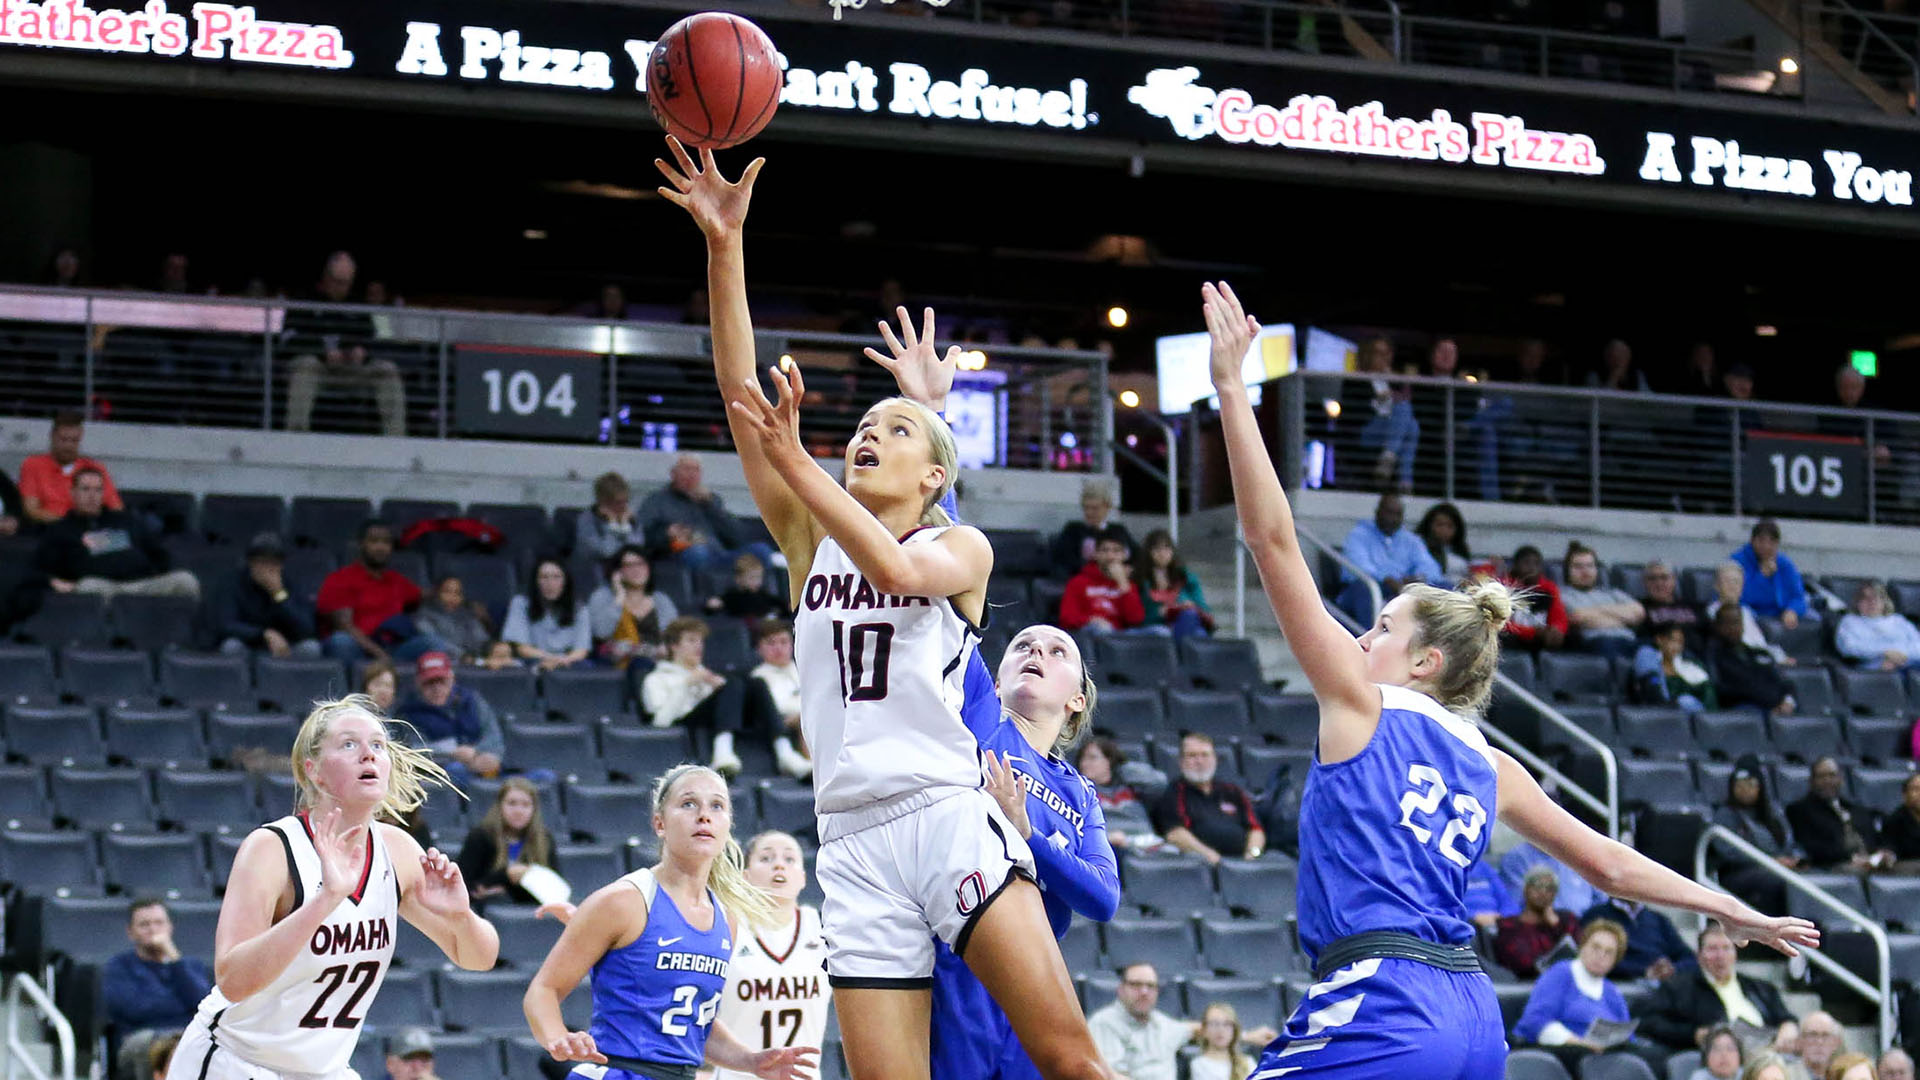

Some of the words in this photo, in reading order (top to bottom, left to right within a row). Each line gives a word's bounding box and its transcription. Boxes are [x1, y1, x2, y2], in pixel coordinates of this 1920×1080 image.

[396, 22, 447, 75] A
[460, 26, 614, 90] Pizza
[777, 52, 879, 111] an't
[889, 62, 1088, 129] Refuse!
[1215, 90, 1467, 160] Godfather's
[1640, 132, 1682, 182] A
[1691, 136, 1816, 196] Pizza
[1823, 150, 1912, 204] You
[482, 369, 577, 416] 104
[1769, 453, 1844, 498] 105
[804, 573, 931, 611] OMA
[832, 620, 896, 708] 10
[1399, 764, 1487, 868] 22
[298, 961, 380, 1029] 22
[737, 975, 821, 1002] OMAHA
